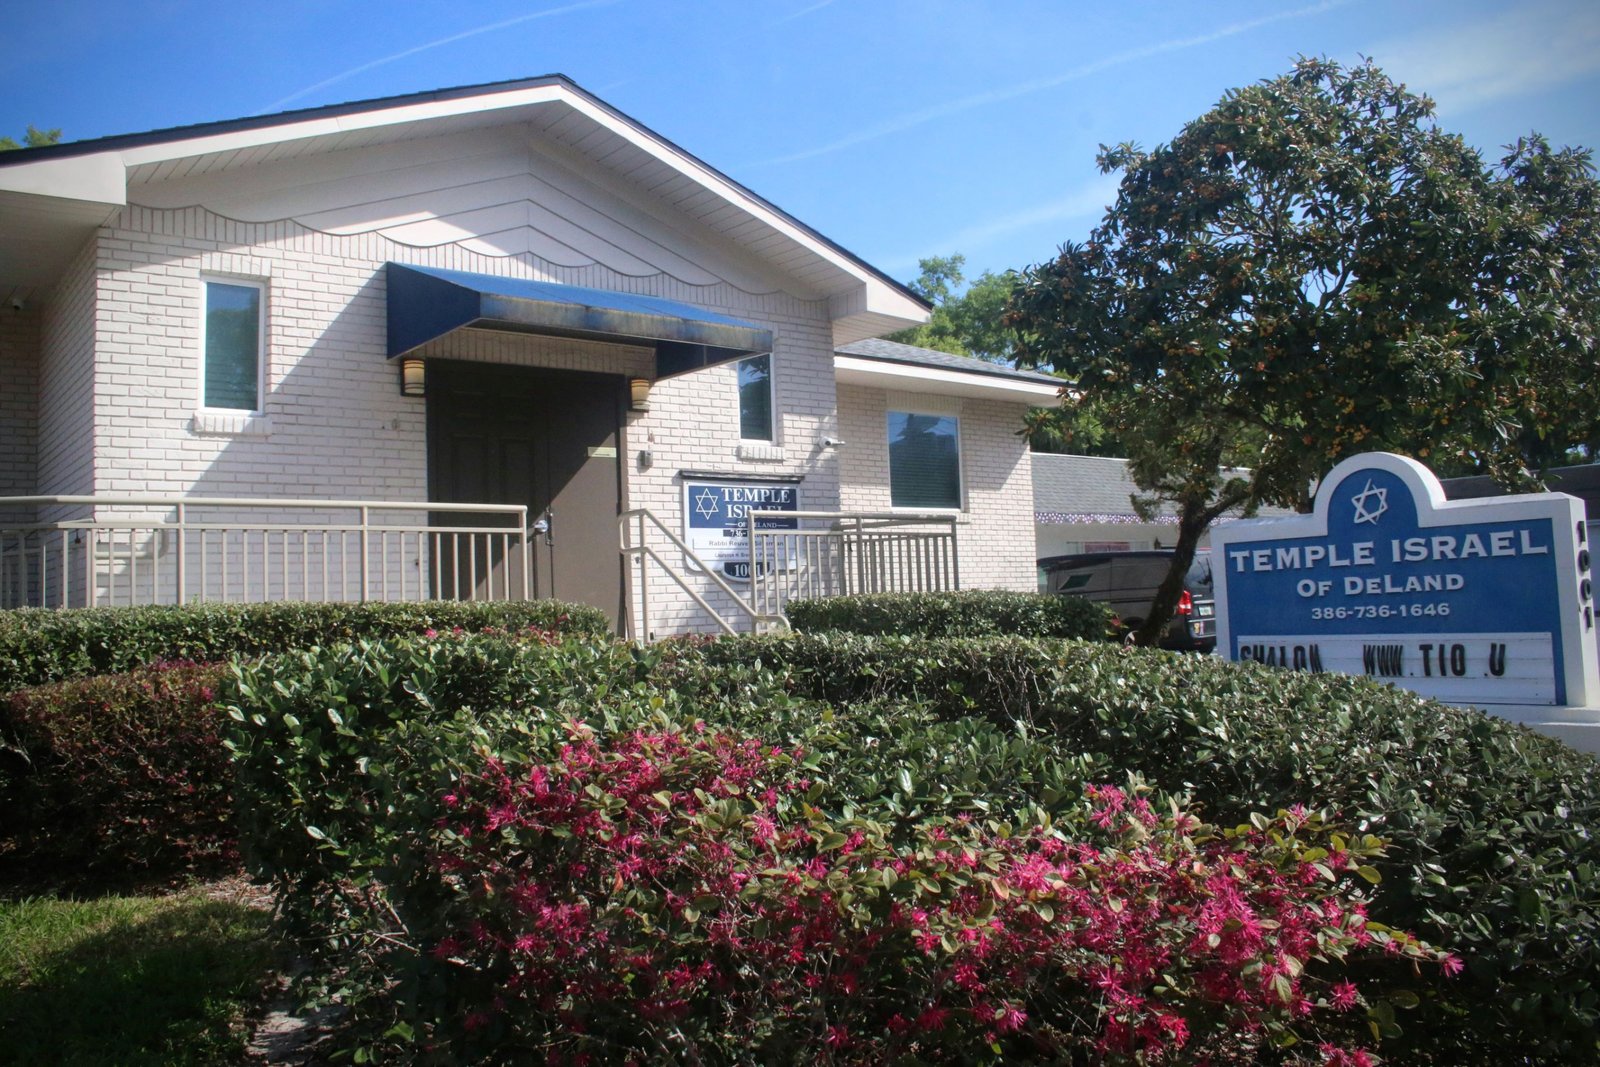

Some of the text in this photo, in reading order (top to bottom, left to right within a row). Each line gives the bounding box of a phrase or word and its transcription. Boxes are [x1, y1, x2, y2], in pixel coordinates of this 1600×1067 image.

[721, 488, 790, 503] TEMPLE
[1230, 530, 1549, 573] TEMPLE ISRAEL
[734, 564, 761, 577] 101
[1311, 602, 1451, 621] 386-736-1646
